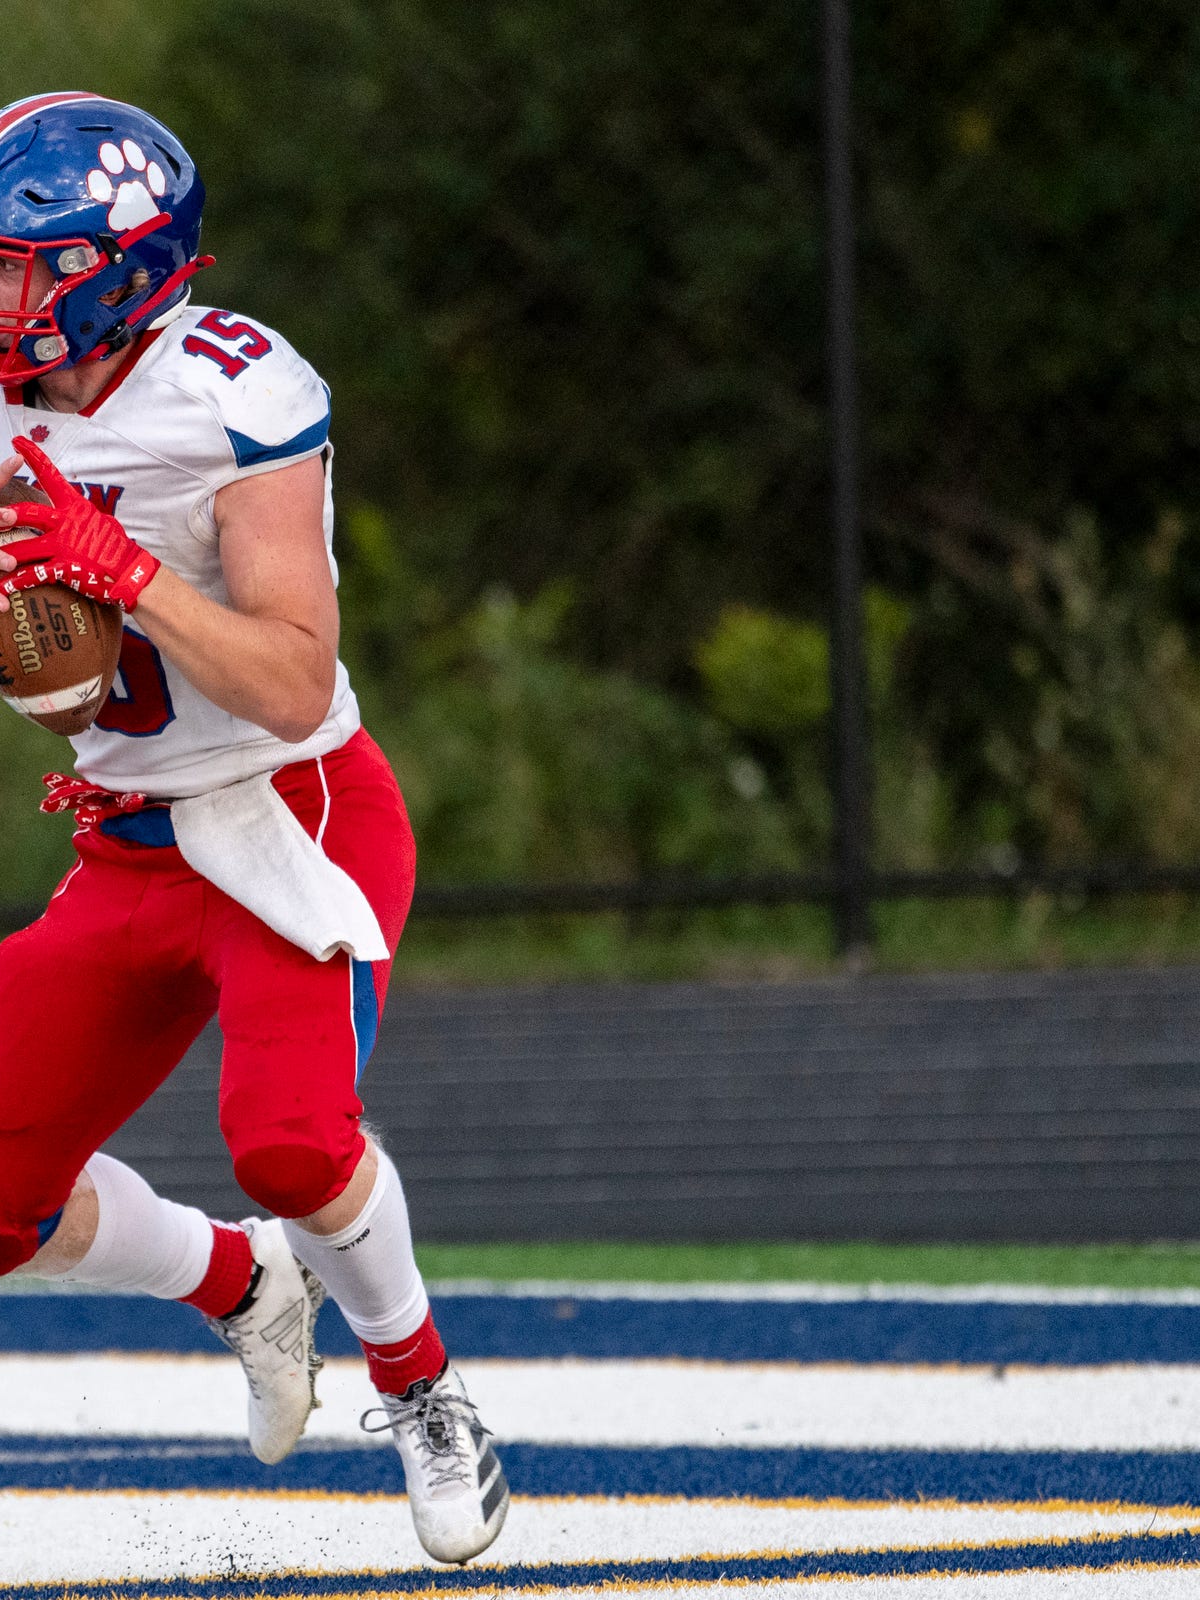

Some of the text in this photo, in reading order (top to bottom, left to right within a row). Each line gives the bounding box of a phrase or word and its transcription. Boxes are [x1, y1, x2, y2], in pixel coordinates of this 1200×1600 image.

[182, 310, 273, 382] 15
[8, 590, 43, 676] Wilson
[43, 597, 73, 652] GST
[70, 602, 88, 636] NCAA
